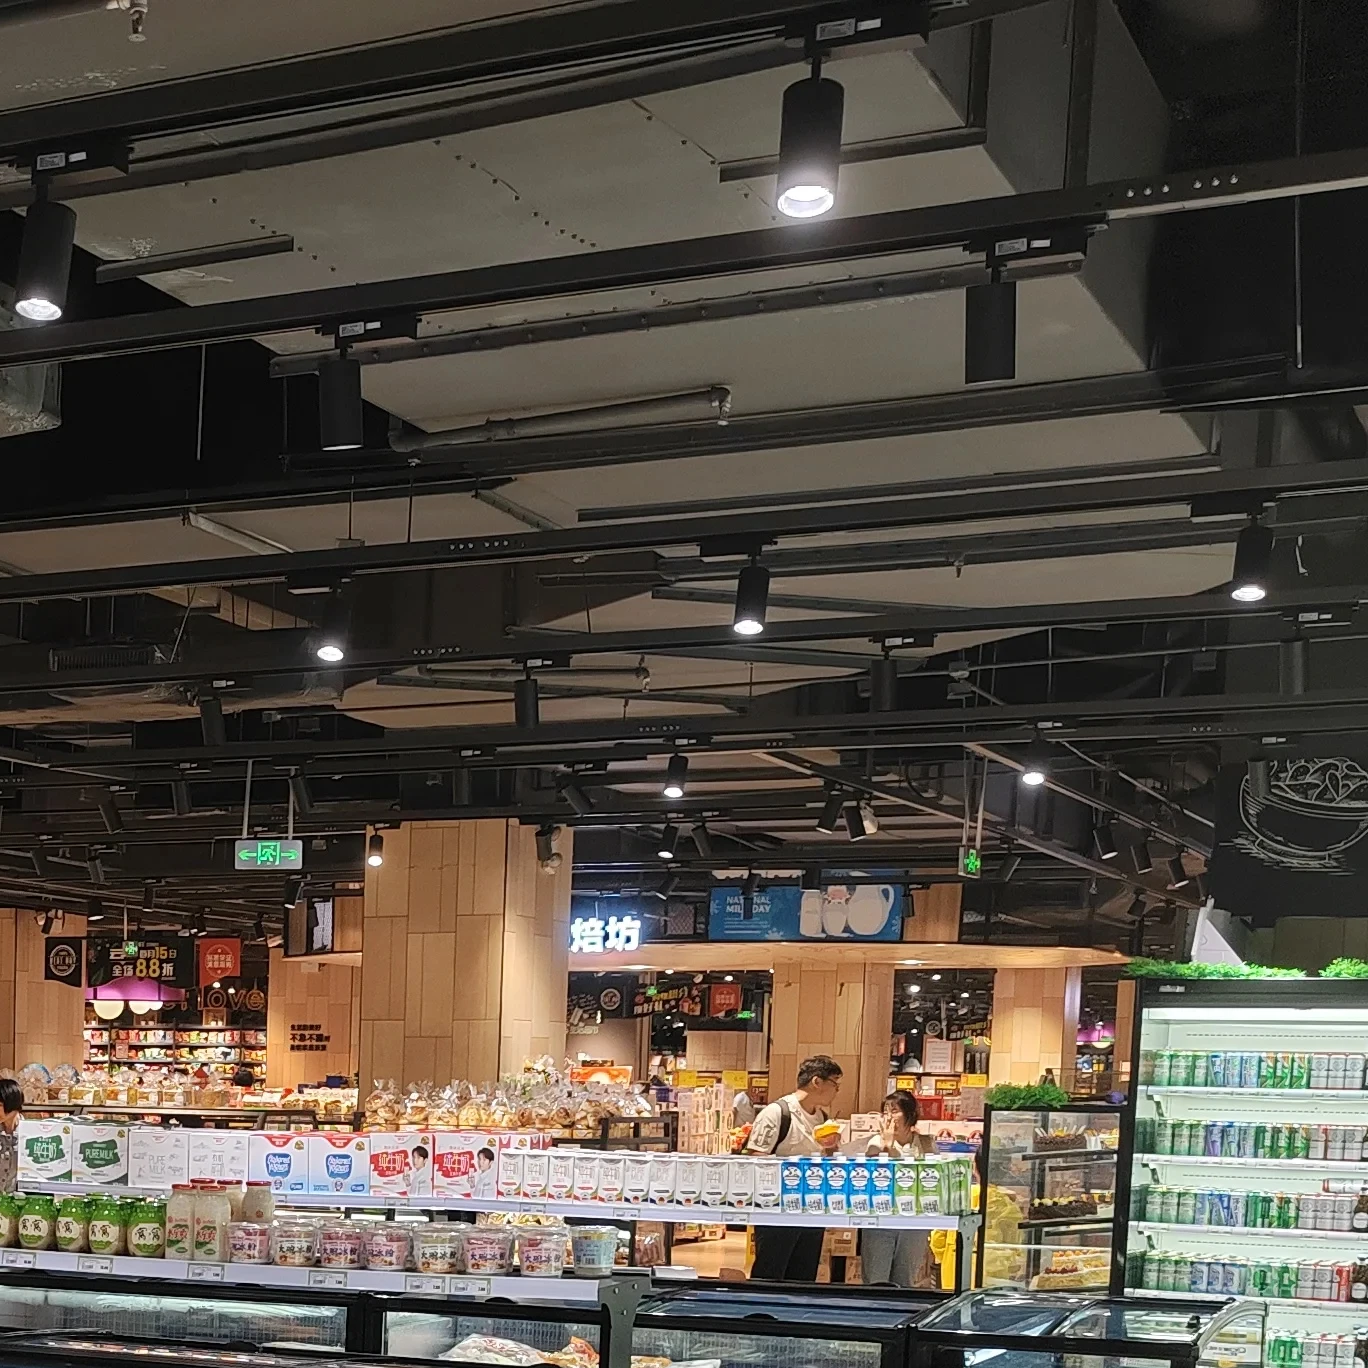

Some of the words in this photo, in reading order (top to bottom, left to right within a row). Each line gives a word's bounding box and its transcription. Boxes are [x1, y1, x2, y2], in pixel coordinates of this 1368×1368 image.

[726, 905, 743, 913] MIL
[753, 905, 771, 913] DAY
[727, 896, 771, 904] NATNAL
[570, 916, 641, 953] 焙坊
[112, 959, 174, 977] 全场8.8折
[34, 1142, 57, 1159] 纯牛奶
[379, 1153, 404, 1171] 纯牛奶
[443, 1154, 469, 1172] 纯牛奶
